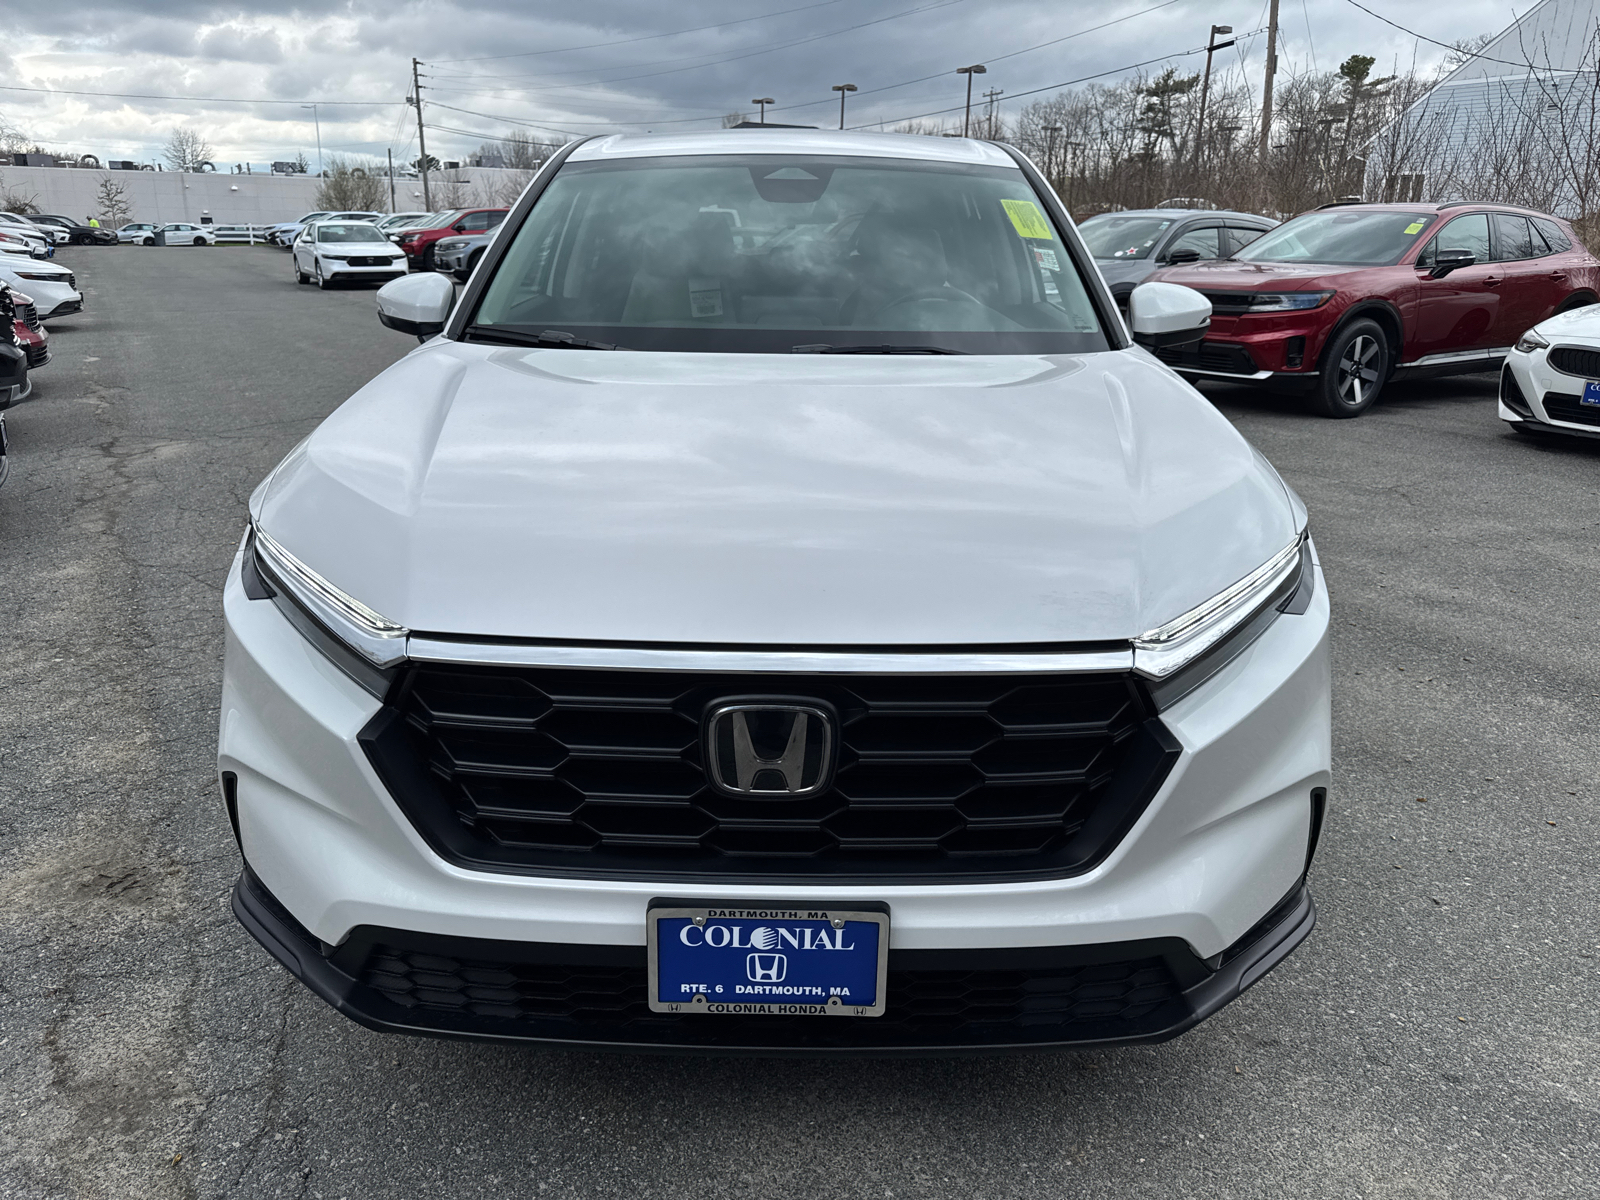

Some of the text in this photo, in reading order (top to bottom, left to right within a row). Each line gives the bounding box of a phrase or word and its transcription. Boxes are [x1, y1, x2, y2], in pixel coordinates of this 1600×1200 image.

[708, 910, 829, 920] DARTMOUTH, MA
[679, 925, 855, 950] COLONIAL
[681, 984, 851, 997] RTE. 6 DARTMOUTH, MA
[707, 1003, 827, 1015] COLONIAL HONDA
